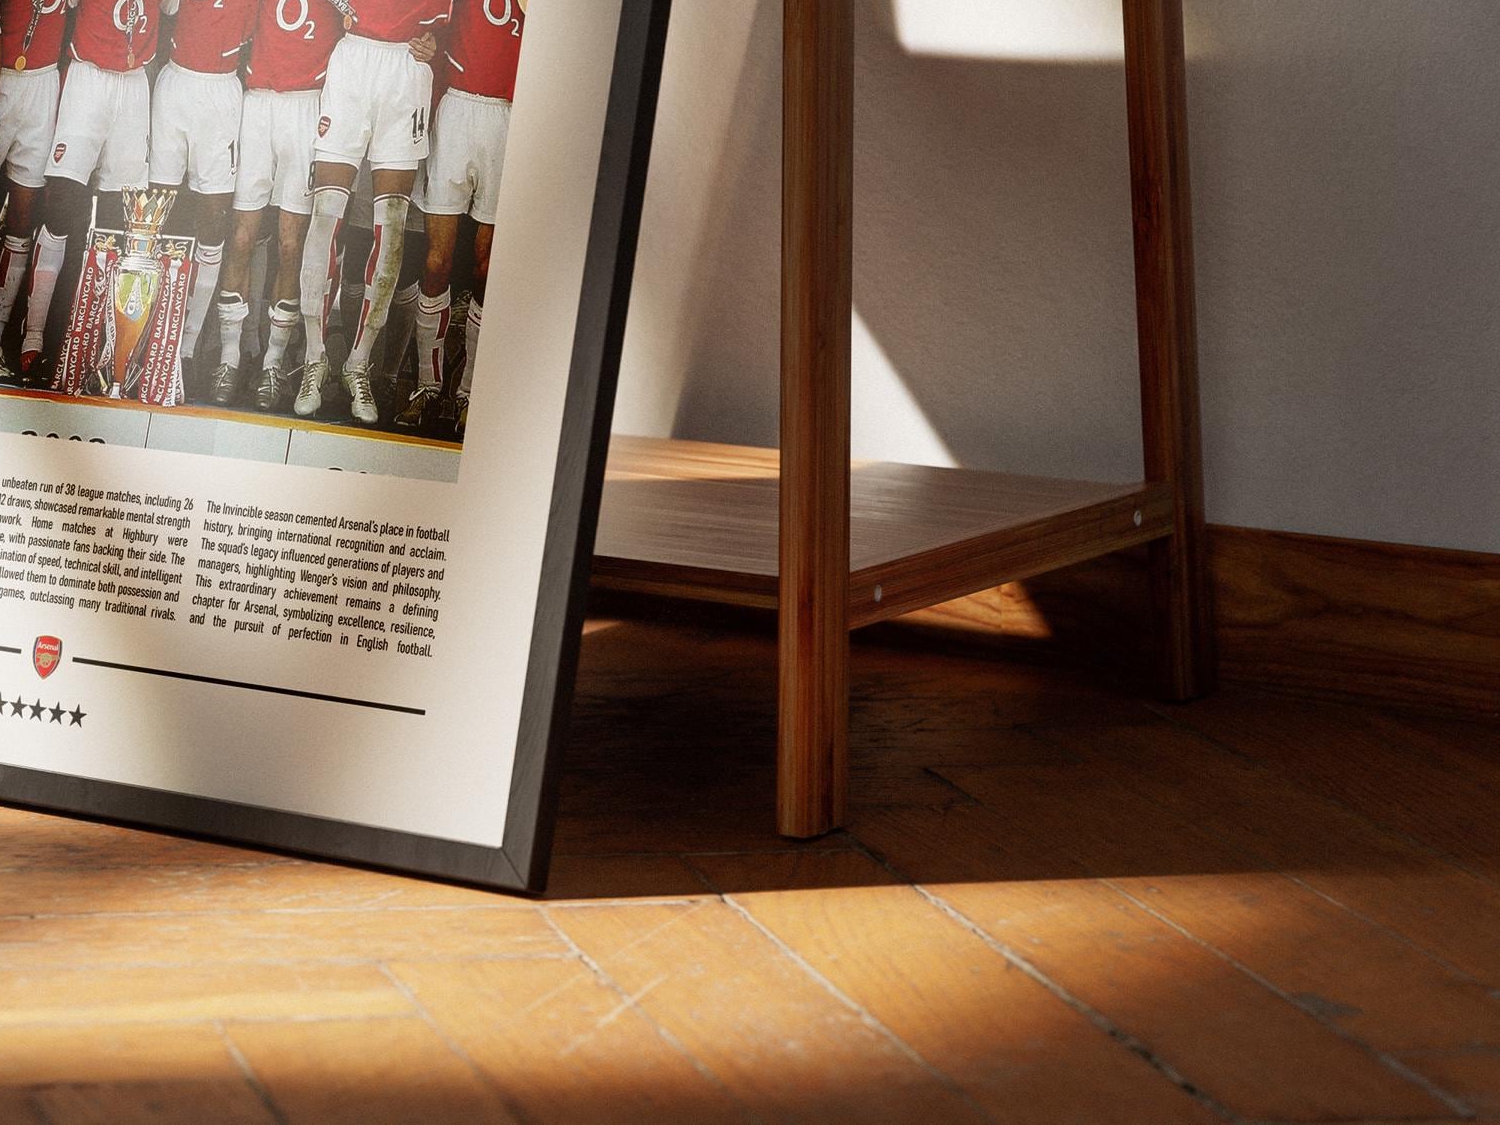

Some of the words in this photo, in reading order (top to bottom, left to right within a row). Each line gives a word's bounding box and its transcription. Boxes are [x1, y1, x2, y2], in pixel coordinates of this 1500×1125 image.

[75, 267, 94, 332] BARCLAYCARD
[170, 273, 186, 341] BARCLAYCARD
[1, 477, 38, 492] unbeaten
[39, 483, 54, 494] run
[55, 483, 65, 495] of
[64, 483, 76, 497] 38
[77, 485, 105, 502] league
[106, 491, 142, 506] matches,
[144, 494, 182, 513] including
[183, 498, 194, 511] 26
[7, 495, 33, 511] draws,
[34, 499, 78, 515] showcased
[78, 506, 126, 521] remarkable
[126, 512, 155, 525] mental
[155, 514, 191, 531] strength
[31, 516, 54, 530] Home
[61, 522, 97, 536] matches
[104, 527, 114, 539] at
[122, 527, 159, 547] Highbury
[168, 536, 189, 548] were
[203, 519, 234, 537] history,
[237, 523, 273, 543] bringing
[276, 528, 332, 547] international
[335, 538, 385, 554] recognition
[389, 544, 406, 556] and
[409, 546, 447, 562] acclaim.
[207, 501, 222, 514] The
[222, 503, 263, 519] Invincible
[264, 511, 294, 523] season
[295, 514, 338, 529] cemented
[338, 517, 379, 534] Arsenal's
[379, 522, 405, 538] place
[405, 525, 415, 538] in
[416, 526, 450, 543] football
[9, 533, 26, 545] with
[27, 536, 71, 551] passionate
[73, 539, 91, 554] fans
[92, 542, 125, 561] backing
[127, 547, 147, 561] their
[149, 550, 167, 564] side.
[171, 552, 186, 566] The
[28, 553, 38, 564] of
[37, 556, 63, 569] speed,
[64, 557, 102, 574] technical
[102, 563, 122, 578] skill,
[123, 567, 140, 579] and
[140, 567, 183, 586] intelligent
[201, 537, 216, 551] The
[217, 543, 249, 556] squad's
[250, 544, 279, 562] legacy
[281, 548, 326, 566] influenced
[327, 556, 380, 573] generations
[381, 561, 392, 574] of
[391, 563, 426, 580] players
[427, 568, 445, 581] and
[26, 570, 47, 584] them
[48, 574, 58, 586] to
[58, 575, 97, 591] dominate
[97, 580, 116, 594] both
[117, 585, 162, 601] possession
[164, 591, 181, 603] and
[196, 574, 213, 589] This
[218, 580, 277, 600] extraordinary
[283, 588, 339, 606] achievement
[345, 597, 382, 612] remains
[389, 603, 395, 614] a
[402, 603, 439, 623] defining
[198, 559, 241, 575] managers,
[245, 562, 296, 584] highlighting
[300, 569, 338, 587] Wenger's
[342, 576, 368, 591] vision
[371, 580, 390, 593] and
[392, 582, 441, 603] philosophy.
[30, 591, 75, 610] outclassing
[78, 598, 102, 613] many
[105, 600, 148, 618] traditional
[150, 607, 176, 621] rivals.
[192, 593, 226, 610] chapter
[228, 598, 241, 611] for
[243, 600, 279, 619] Arsenal,
[282, 608, 334, 628] symbolizing
[337, 615, 386, 634] excellence,
[390, 622, 436, 640] resilience,
[189, 613, 206, 626] and
[213, 615, 227, 628] the
[233, 620, 265, 634] pursuit
[272, 624, 282, 636] of
[288, 628, 333, 644] perfection
[340, 633, 349, 646] in
[356, 635, 389, 653] English
[397, 641, 433, 658] football.
